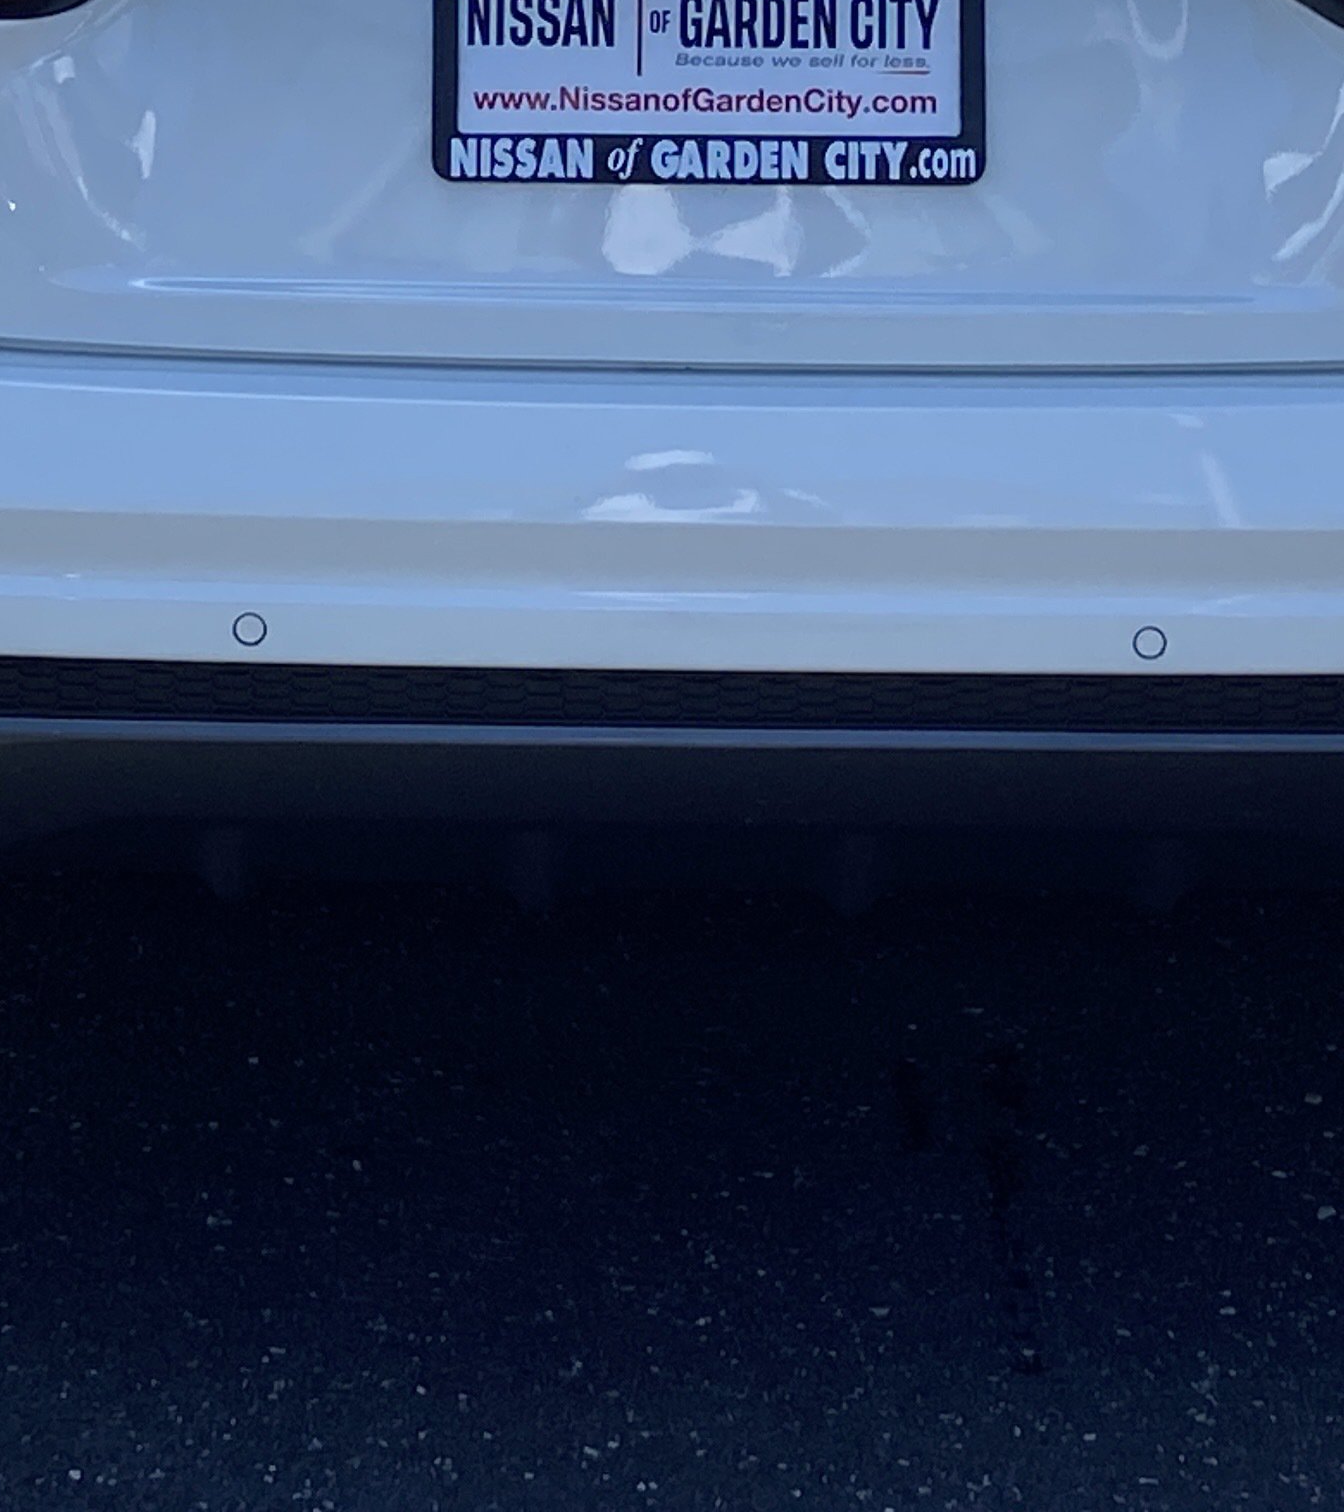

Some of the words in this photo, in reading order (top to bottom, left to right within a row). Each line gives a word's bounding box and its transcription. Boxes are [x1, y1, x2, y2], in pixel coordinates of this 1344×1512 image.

[649, 10, 671, 34] OF
[675, 53, 764, 67] Because
[771, 56, 802, 68] we
[809, 54, 845, 68] sell
[851, 54, 878, 68] for
[884, 54, 930, 68] less.
[473, 86, 938, 119] www.NissanofGardenCity.com
[450, 137, 594, 178] NISSAN
[607, 137, 644, 180] of
[650, 138, 809, 180] GARDEN
[824, 141, 976, 180] CITY.com
